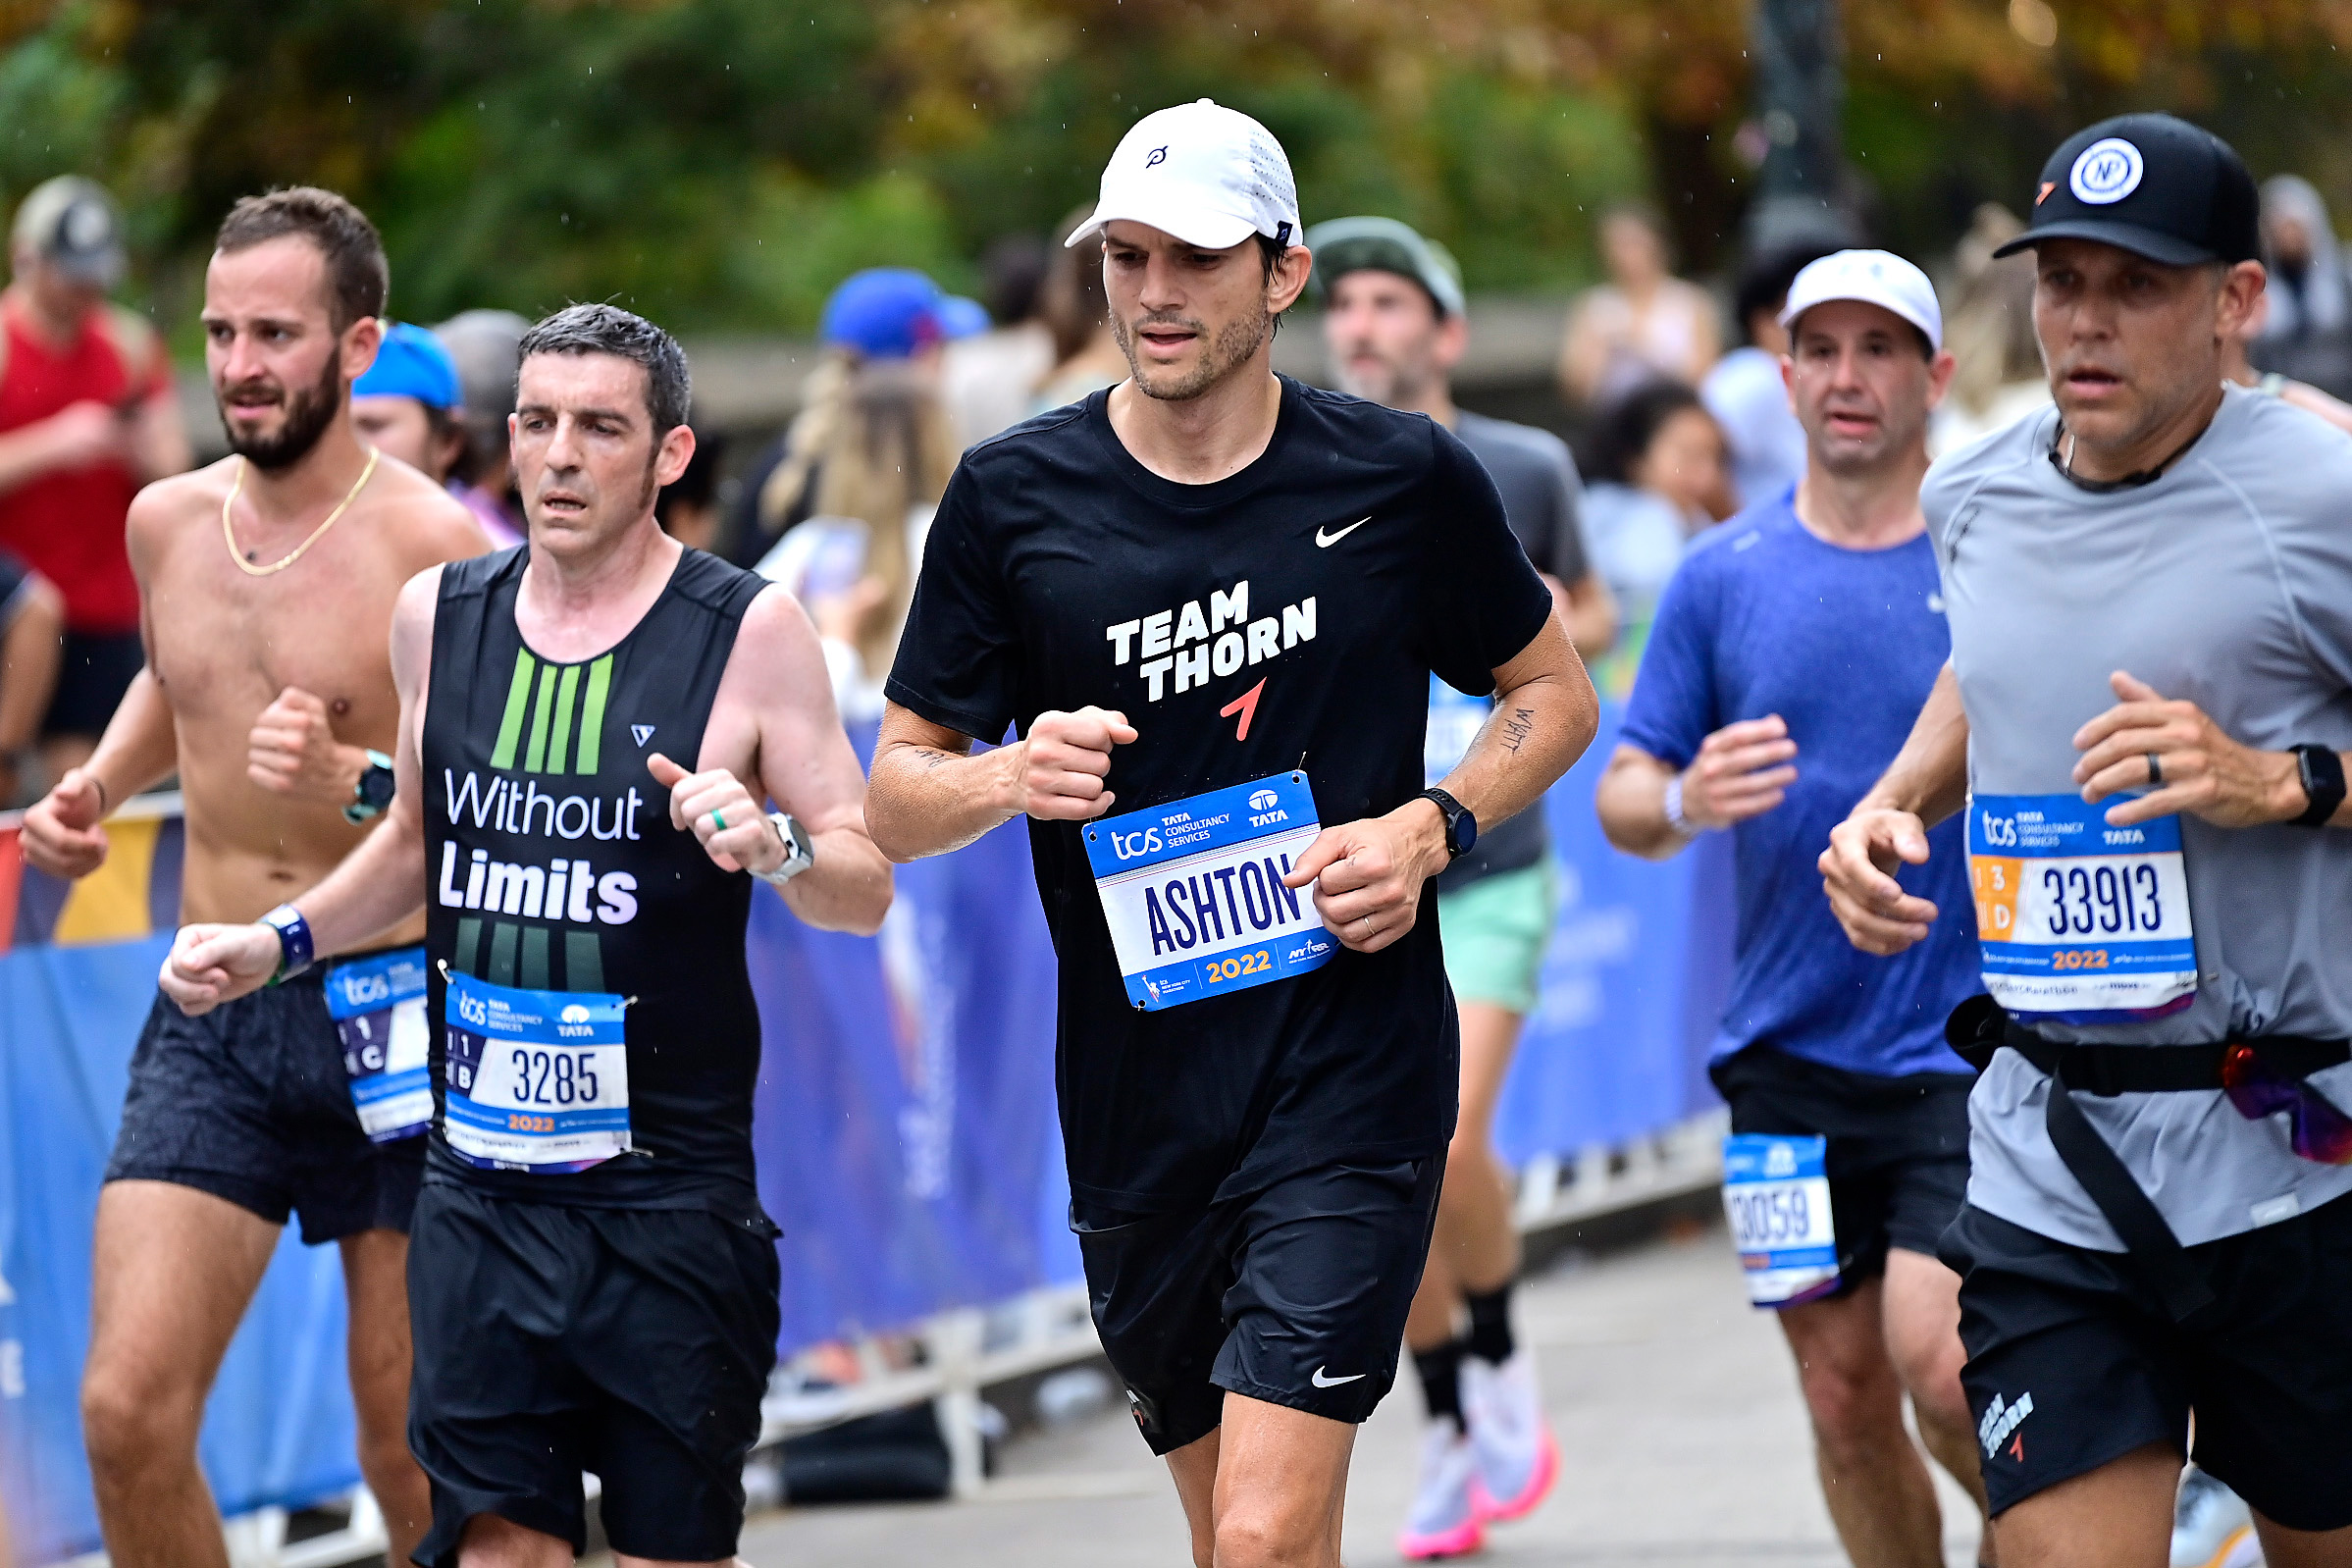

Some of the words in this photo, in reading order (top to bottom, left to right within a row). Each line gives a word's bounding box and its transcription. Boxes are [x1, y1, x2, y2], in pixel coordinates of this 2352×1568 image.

[1107, 580, 1248, 666] TEAM
[1139, 596, 1316, 703] THORN
[444, 767, 644, 841] Without
[2015, 810, 2045, 822] TATA
[1161, 812, 1192, 827] TATA
[1165, 813, 1230, 838] CONSULTANCY
[1248, 810, 1289, 828] TATA
[1982, 809, 2017, 848] tcs
[2017, 821, 2085, 835] CONSULTANCY
[1111, 826, 1164, 861] tcs
[1168, 830, 1211, 849] SERVICES
[2102, 829, 2146, 846] TATA
[439, 839, 638, 925] Limits
[1991, 864, 2007, 892] 3
[1144, 853, 1302, 957] ASHTON
[2044, 863, 2162, 935] 33913
[1995, 904, 2011, 930] D
[1206, 950, 1273, 984] 2022
[2052, 949, 2110, 970] 2022
[458, 989, 487, 1026] tcs
[557, 1024, 595, 1037] TATA
[461, 1034, 470, 1057] 1
[457, 1065, 472, 1090] B
[511, 1049, 599, 1105] 3285
[508, 1114, 555, 1132] 2022
